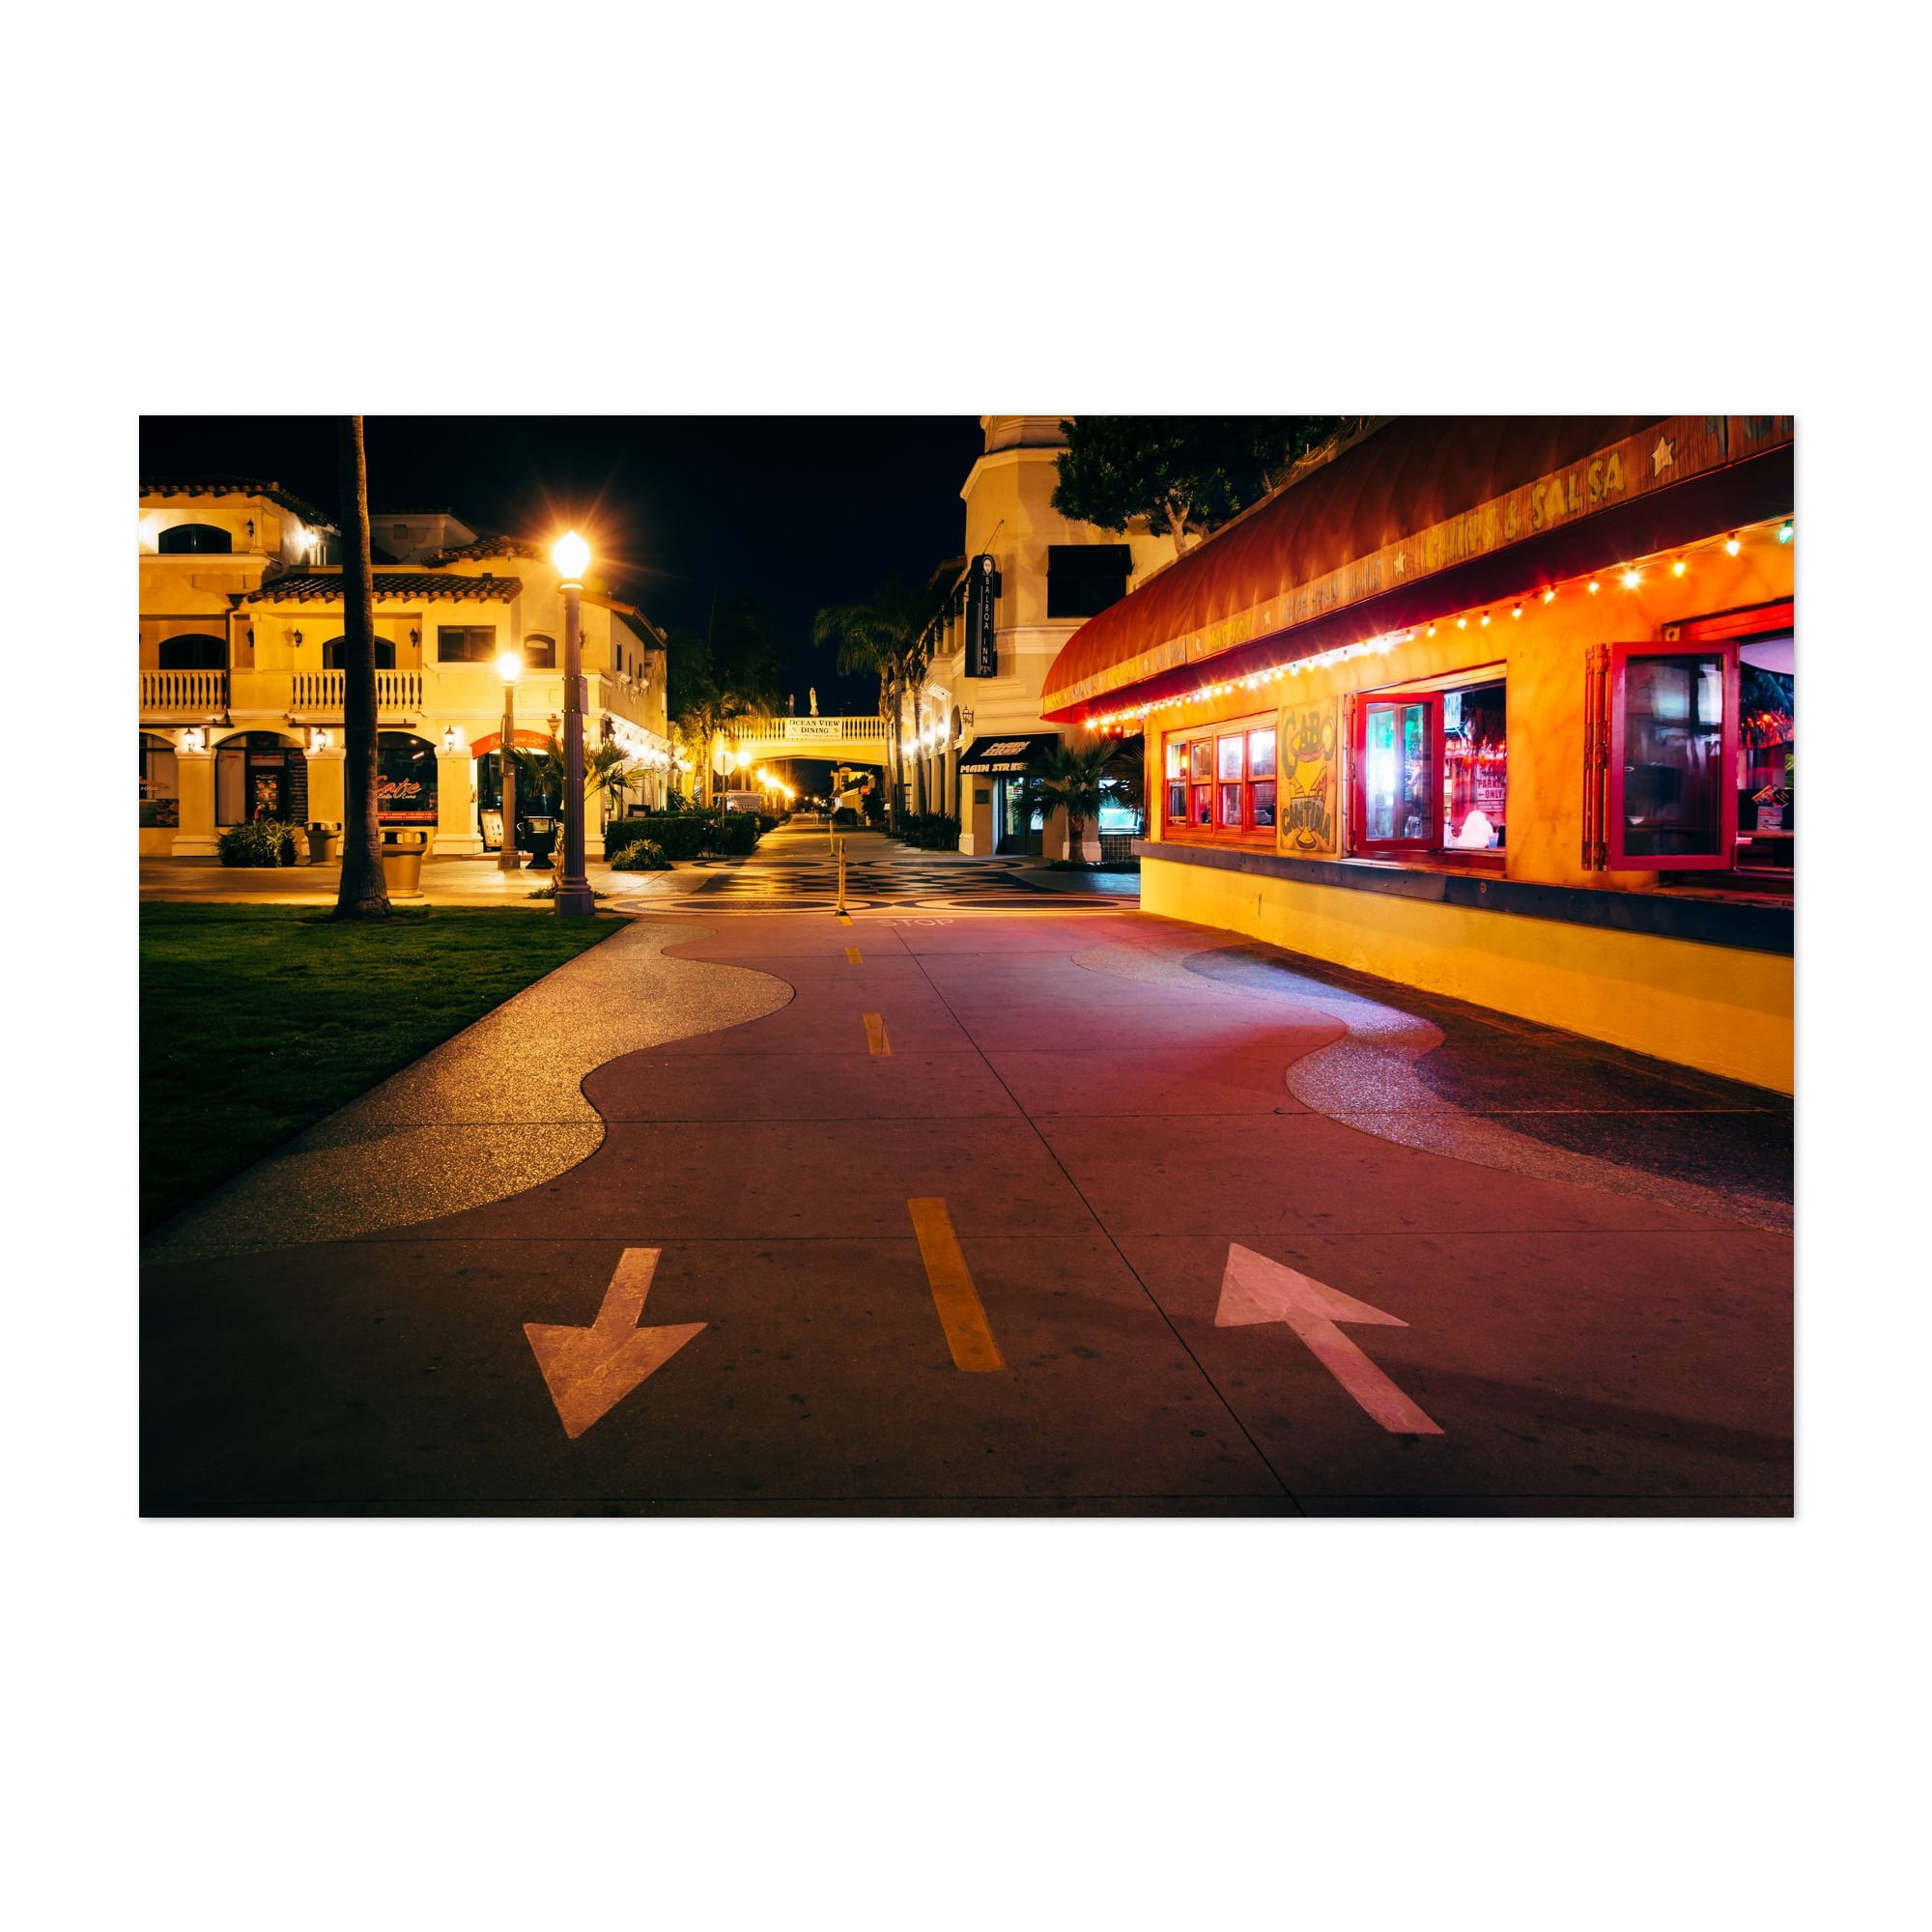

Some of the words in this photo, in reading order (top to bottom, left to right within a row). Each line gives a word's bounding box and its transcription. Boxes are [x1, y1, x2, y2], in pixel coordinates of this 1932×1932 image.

[1425, 503, 1496, 570] CHIPS
[1532, 451, 1627, 530] SALSA
[1282, 710, 1336, 780] CABO
[960, 764, 990, 773] MAIN
[1485, 789, 1502, 798] ONLY
[875, 919, 954, 927] STOP
